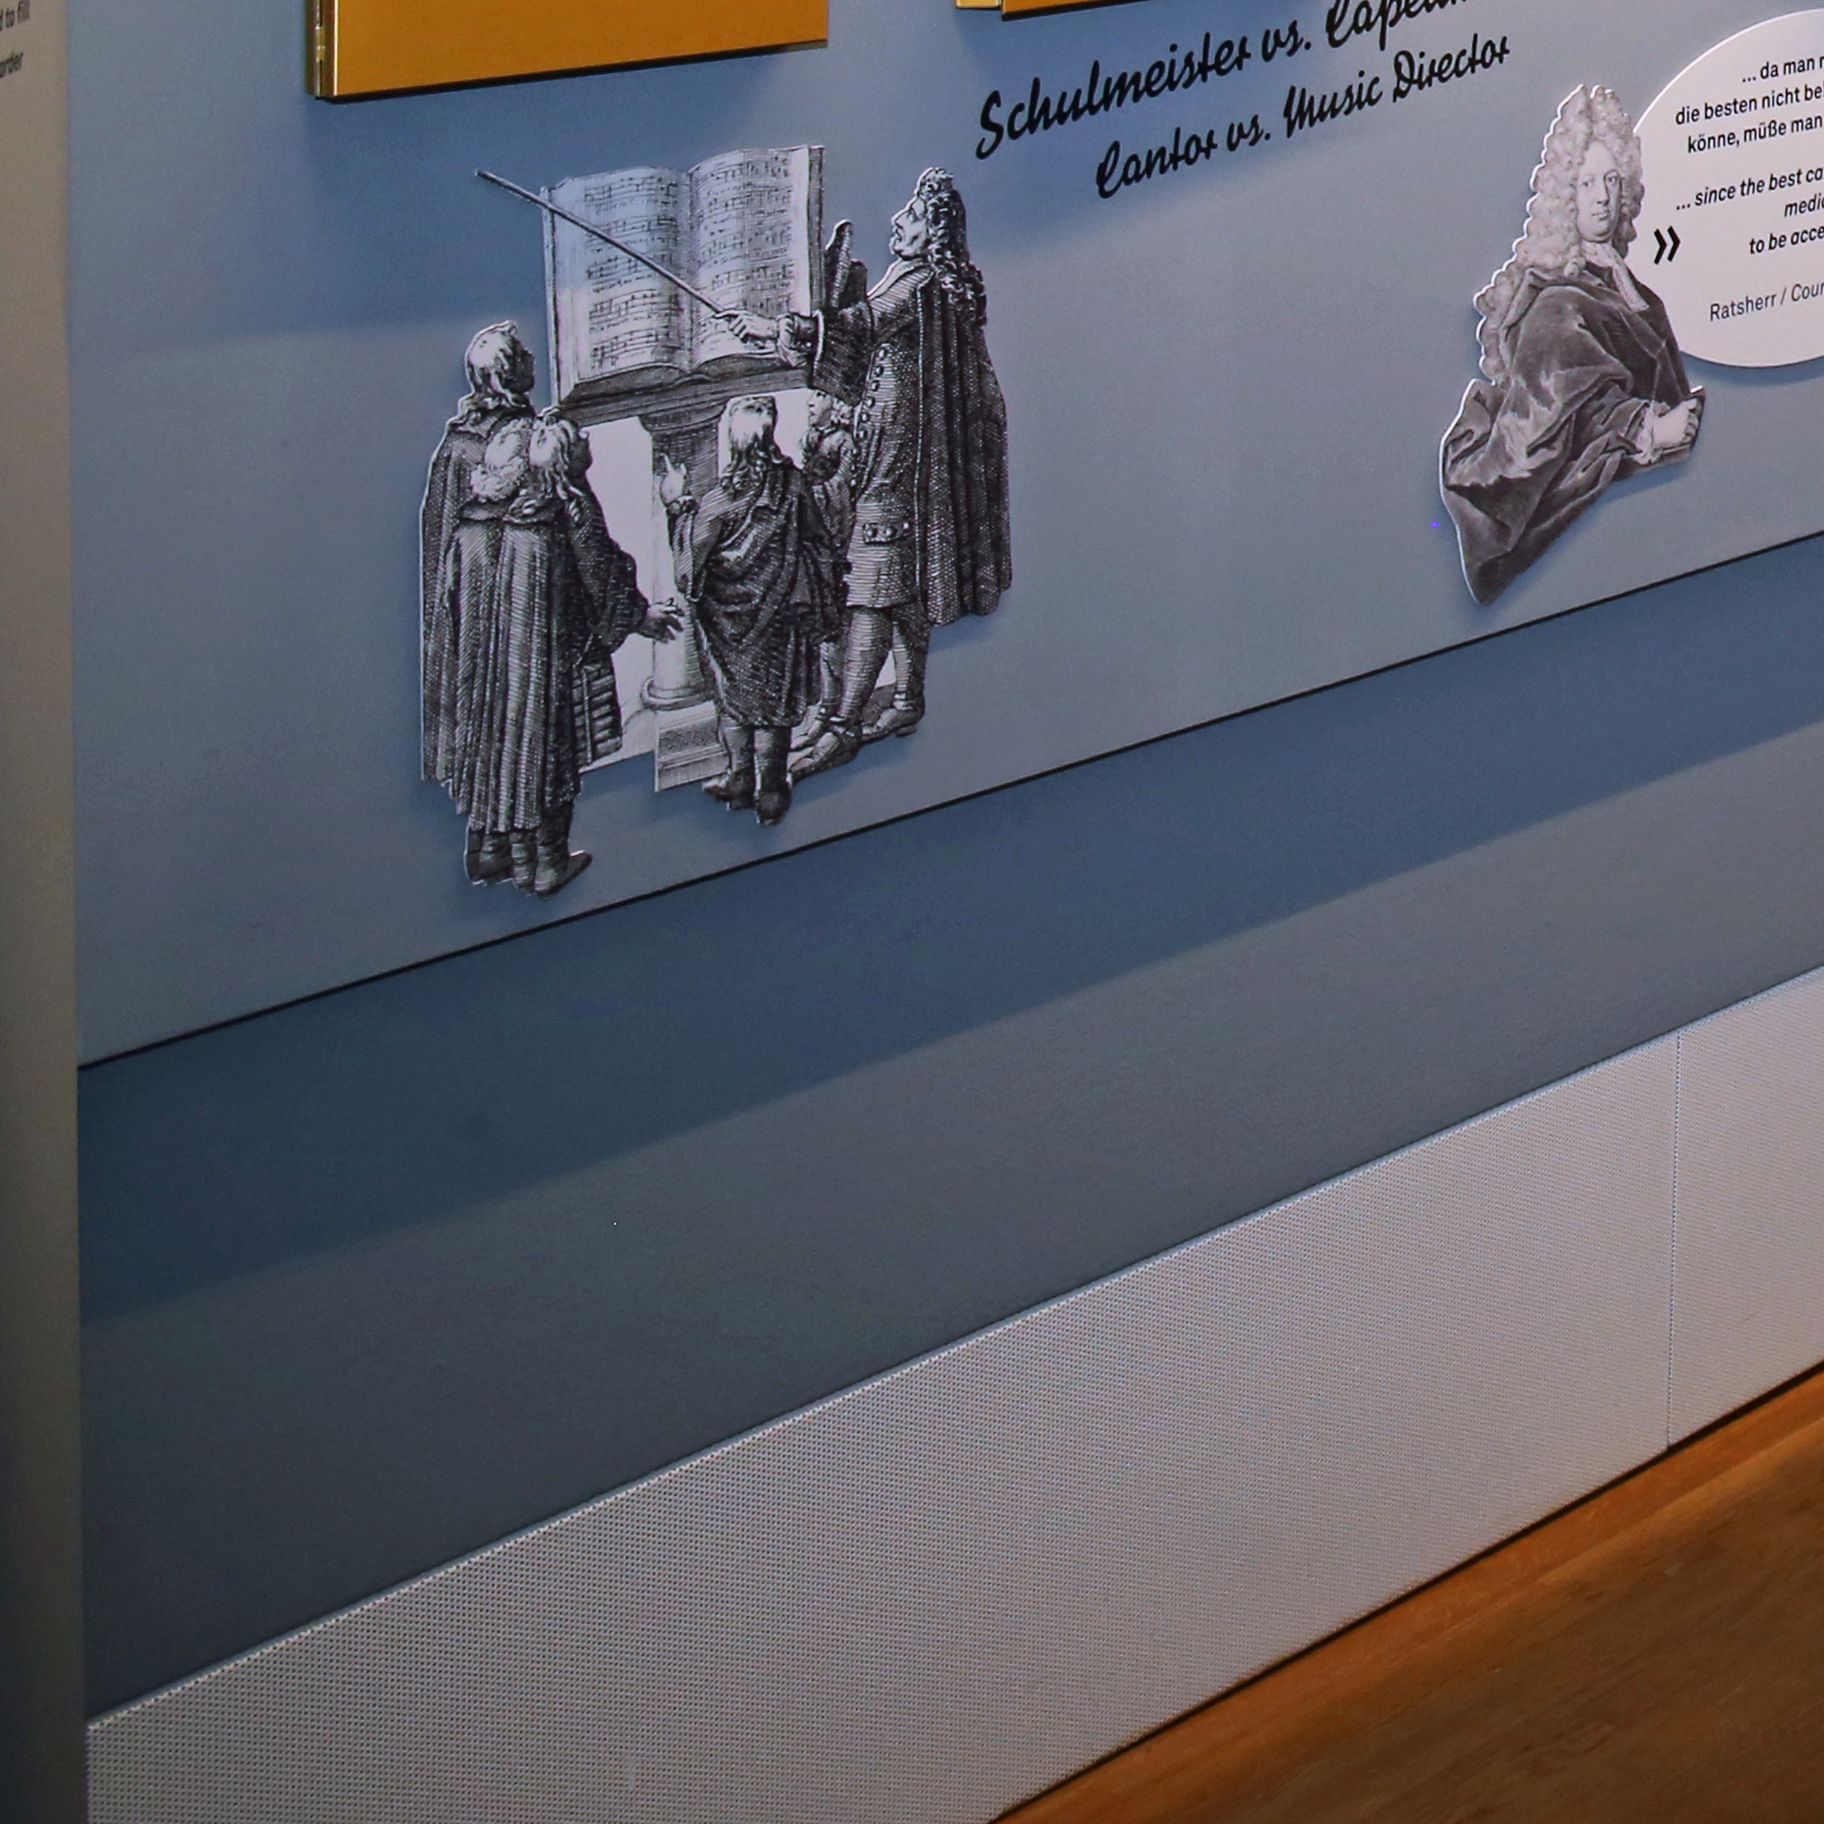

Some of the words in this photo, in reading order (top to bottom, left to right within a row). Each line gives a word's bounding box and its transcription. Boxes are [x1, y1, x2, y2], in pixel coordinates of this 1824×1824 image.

[1760, 60, 1780, 80] da
[1782, 55, 1815, 75] man
[976, 35, 1252, 160] Schulmeister
[1262, 22, 1312, 62] vs.
[1675, 105, 1700, 126] die
[1703, 92, 1758, 121] besten
[1761, 86, 1799, 112] nicht
[1095, 126, 1218, 199] Cantor
[1227, 111, 1270, 152] vs.
[1283, 76, 1384, 138] Music
[1393, 33, 1511, 104] Director
[1687, 127, 1740, 155] könne,
[1743, 119, 1787, 144] müße
[1791, 110, 1822, 133] man
[1695, 184, 1736, 207] since
[1740, 174, 1763, 199] the
[1768, 168, 1802, 192] best
[1749, 236, 1765, 256] to
[1769, 232, 1787, 250] be
[1709, 291, 1777, 323] Ratsherr
